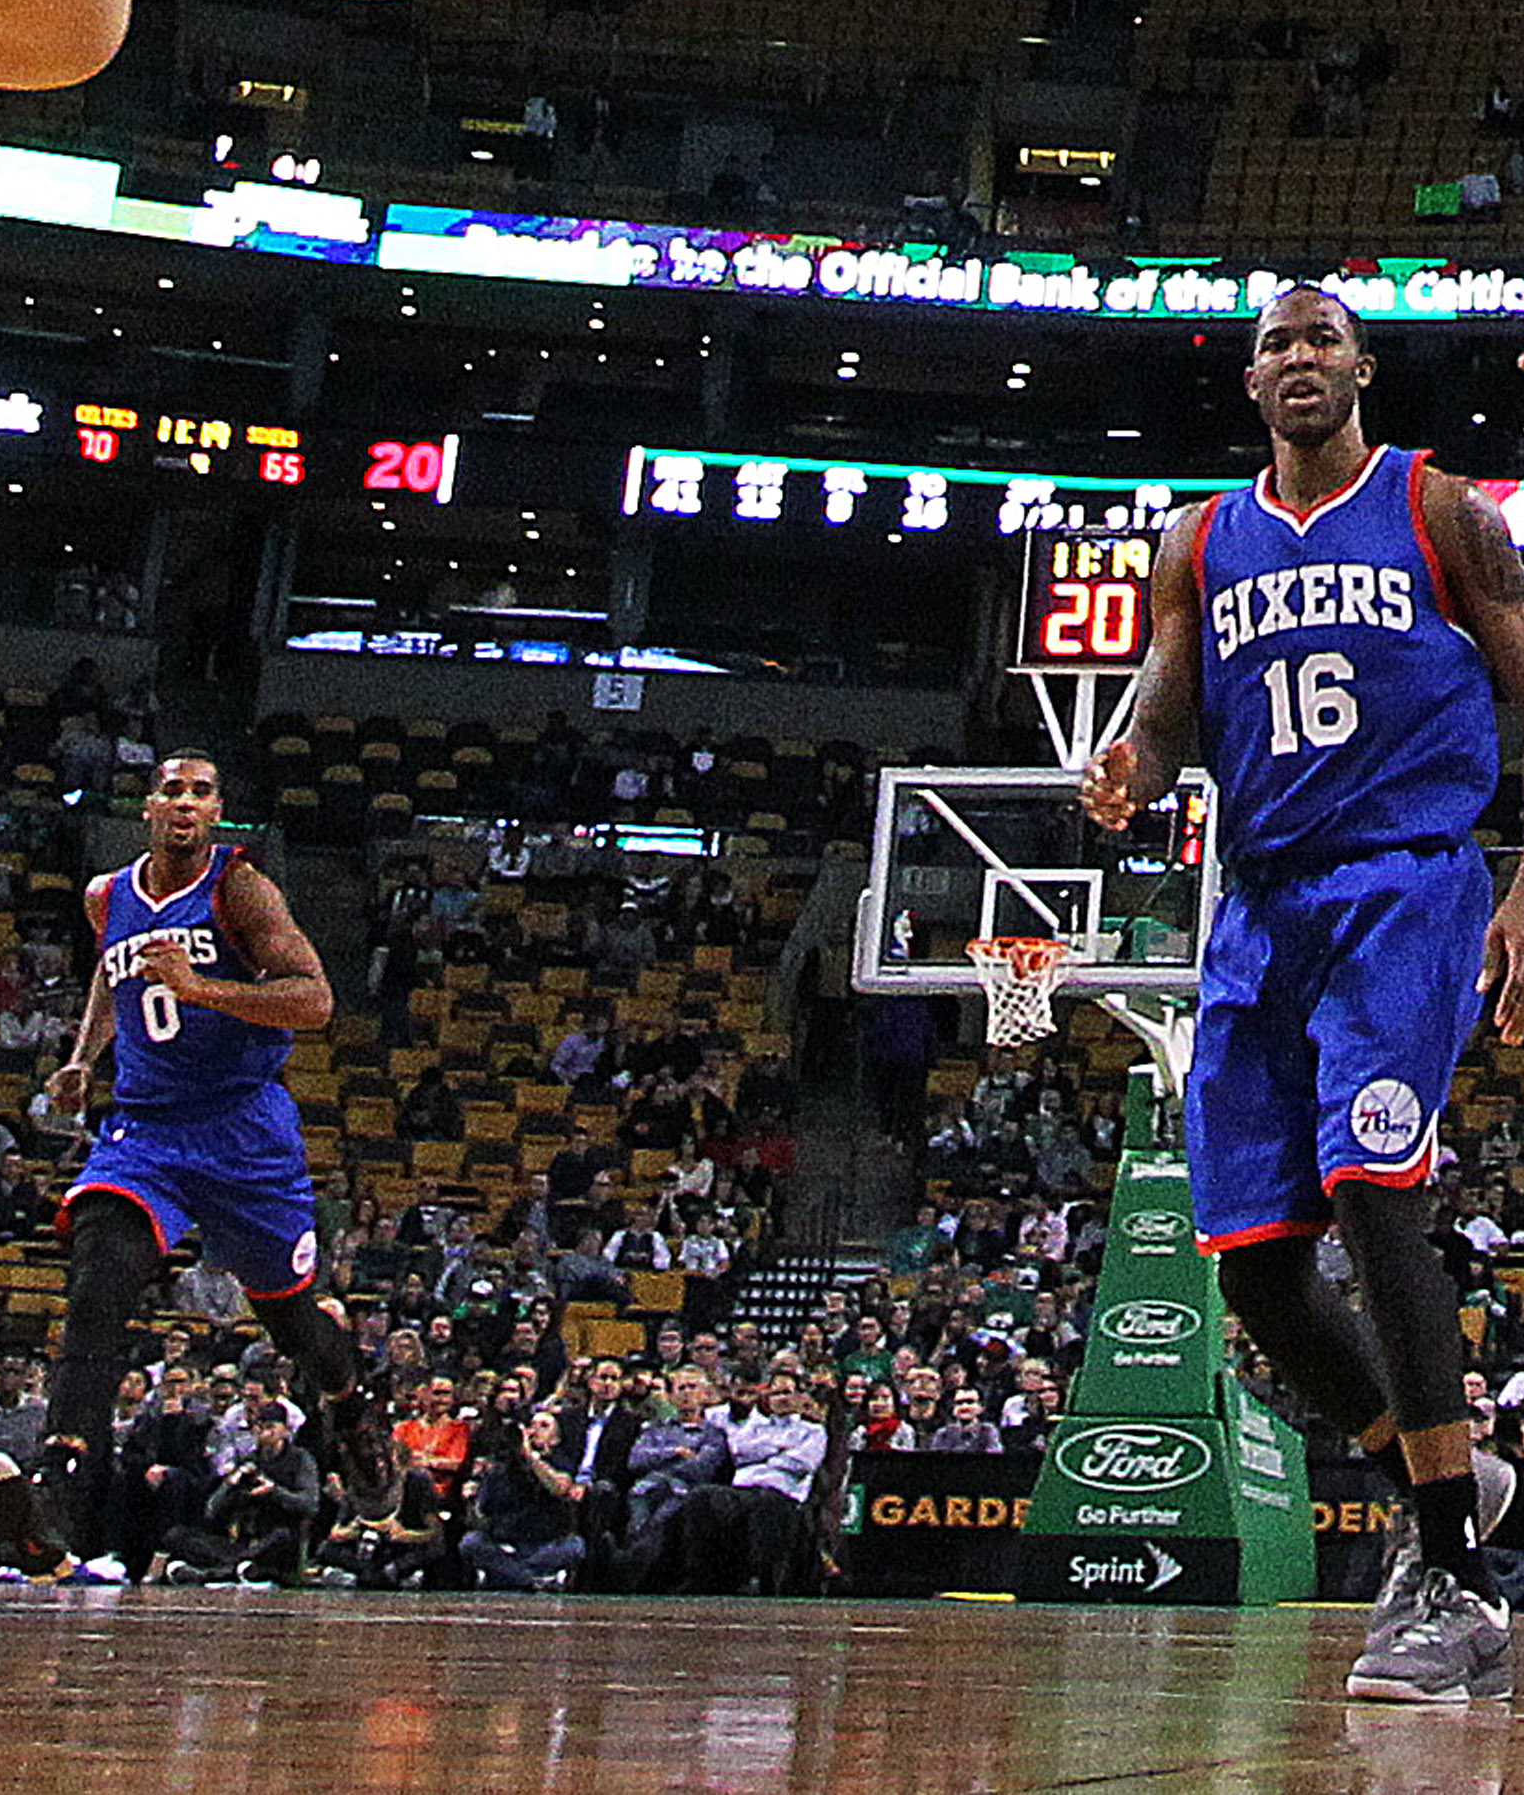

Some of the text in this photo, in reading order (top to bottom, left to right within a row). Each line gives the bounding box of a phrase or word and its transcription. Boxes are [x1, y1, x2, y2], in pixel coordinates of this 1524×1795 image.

[733, 244, 813, 289] the
[820, 250, 982, 302] Official
[988, 260, 1100, 313] Bank
[1105, 265, 1159, 311] of
[1160, 264, 1239, 312] the
[78, 429, 119, 462] 70
[261, 451, 305, 484] 65
[364, 442, 440, 492] 20
[1041, 583, 1142, 657] 20
[1213, 563, 1412, 660] SIXERS
[1263, 652, 1361, 756] 16
[141, 984, 181, 1043] 0
[1115, 1306, 1184, 1336] Ford
[1082, 1432, 1185, 1480] Ford
[871, 1493, 1032, 1529] GARDE
[1077, 1504, 1182, 1527] Go Further
[1069, 1558, 1146, 1591] Sprint
